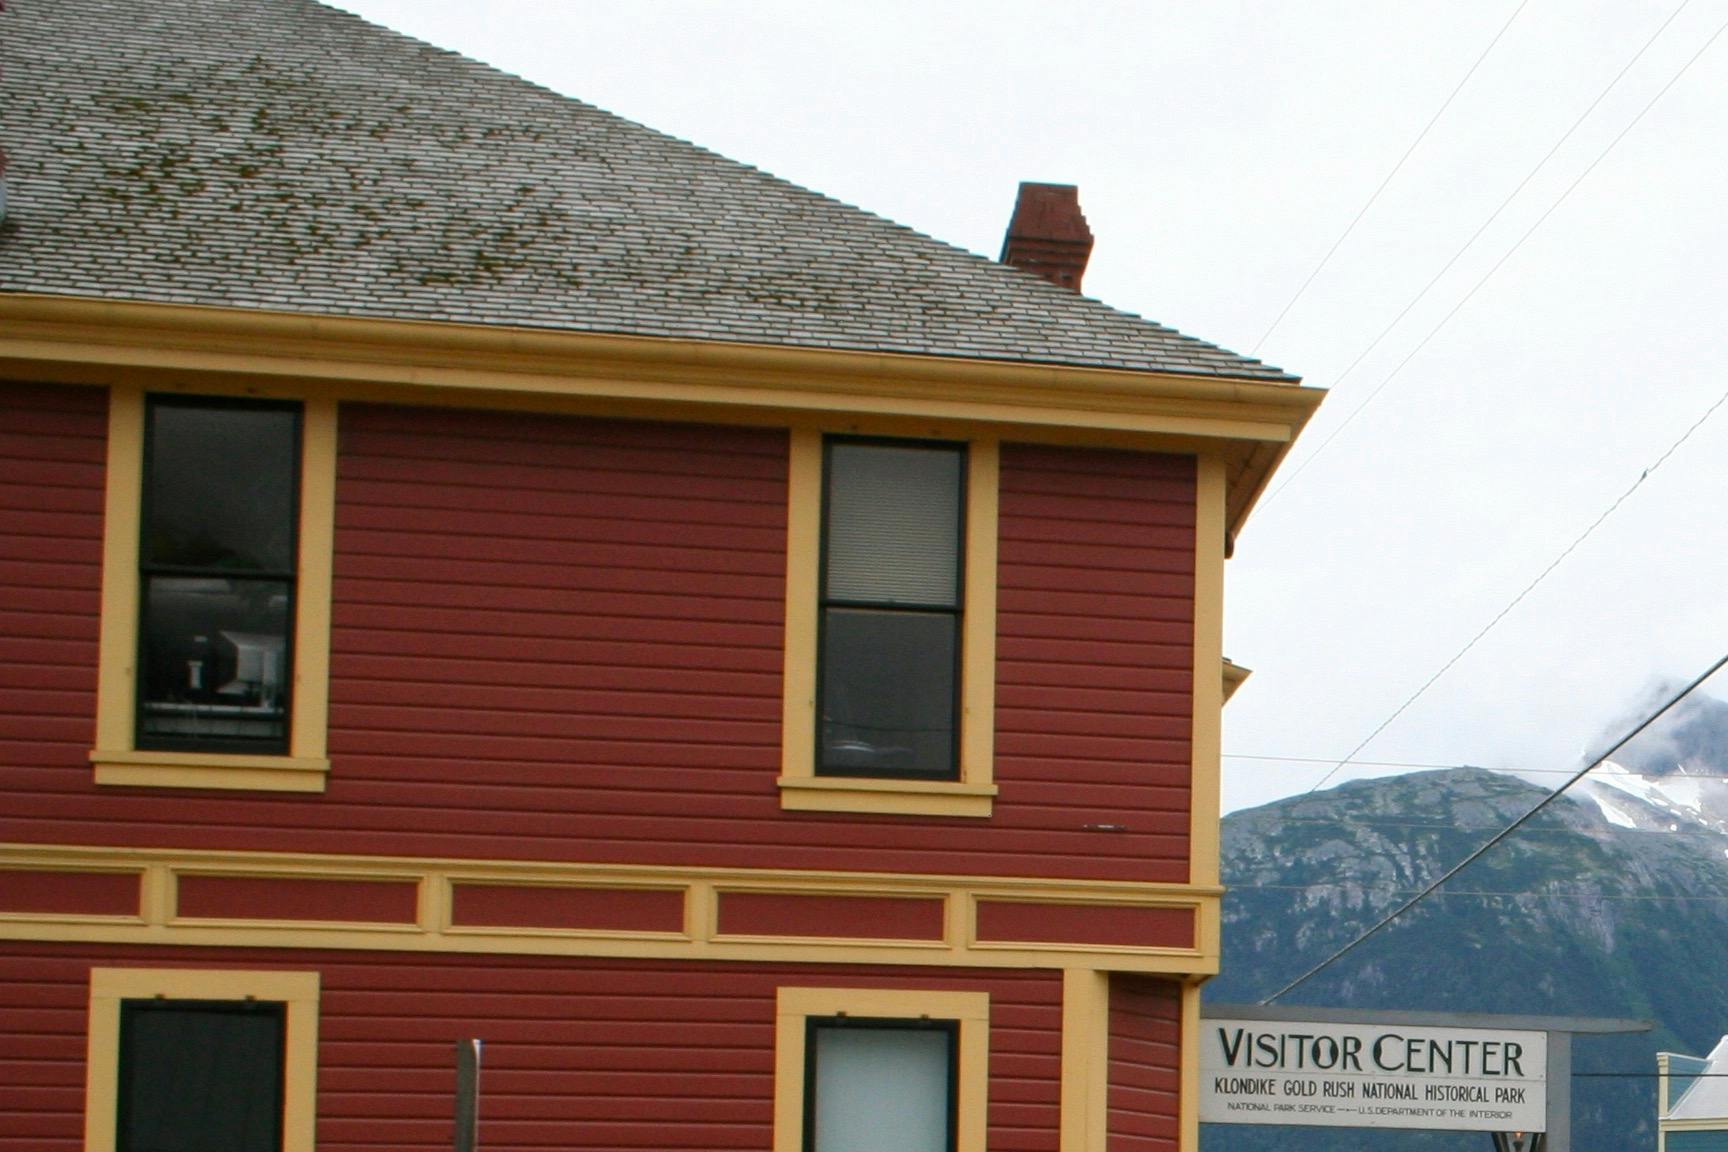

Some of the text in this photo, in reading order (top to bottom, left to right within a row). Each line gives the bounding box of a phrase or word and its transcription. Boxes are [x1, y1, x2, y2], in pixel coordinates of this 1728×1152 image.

[1218, 1027, 1525, 1077] VISITOR CENTER
[1215, 1077, 1526, 1104] KLONDIKE GOLD RUSH NATIONAL HISTORICAL PARK
[1227, 1102, 1270, 1112] NATIONAL
[1273, 1103, 1297, 1113] PARK
[1298, 1104, 1336, 1114] SERVICE
[1436, 1108, 1448, 1117] OF
[1450, 1109, 1465, 1118] THE
[1469, 1110, 1512, 1119] INTERIOR
